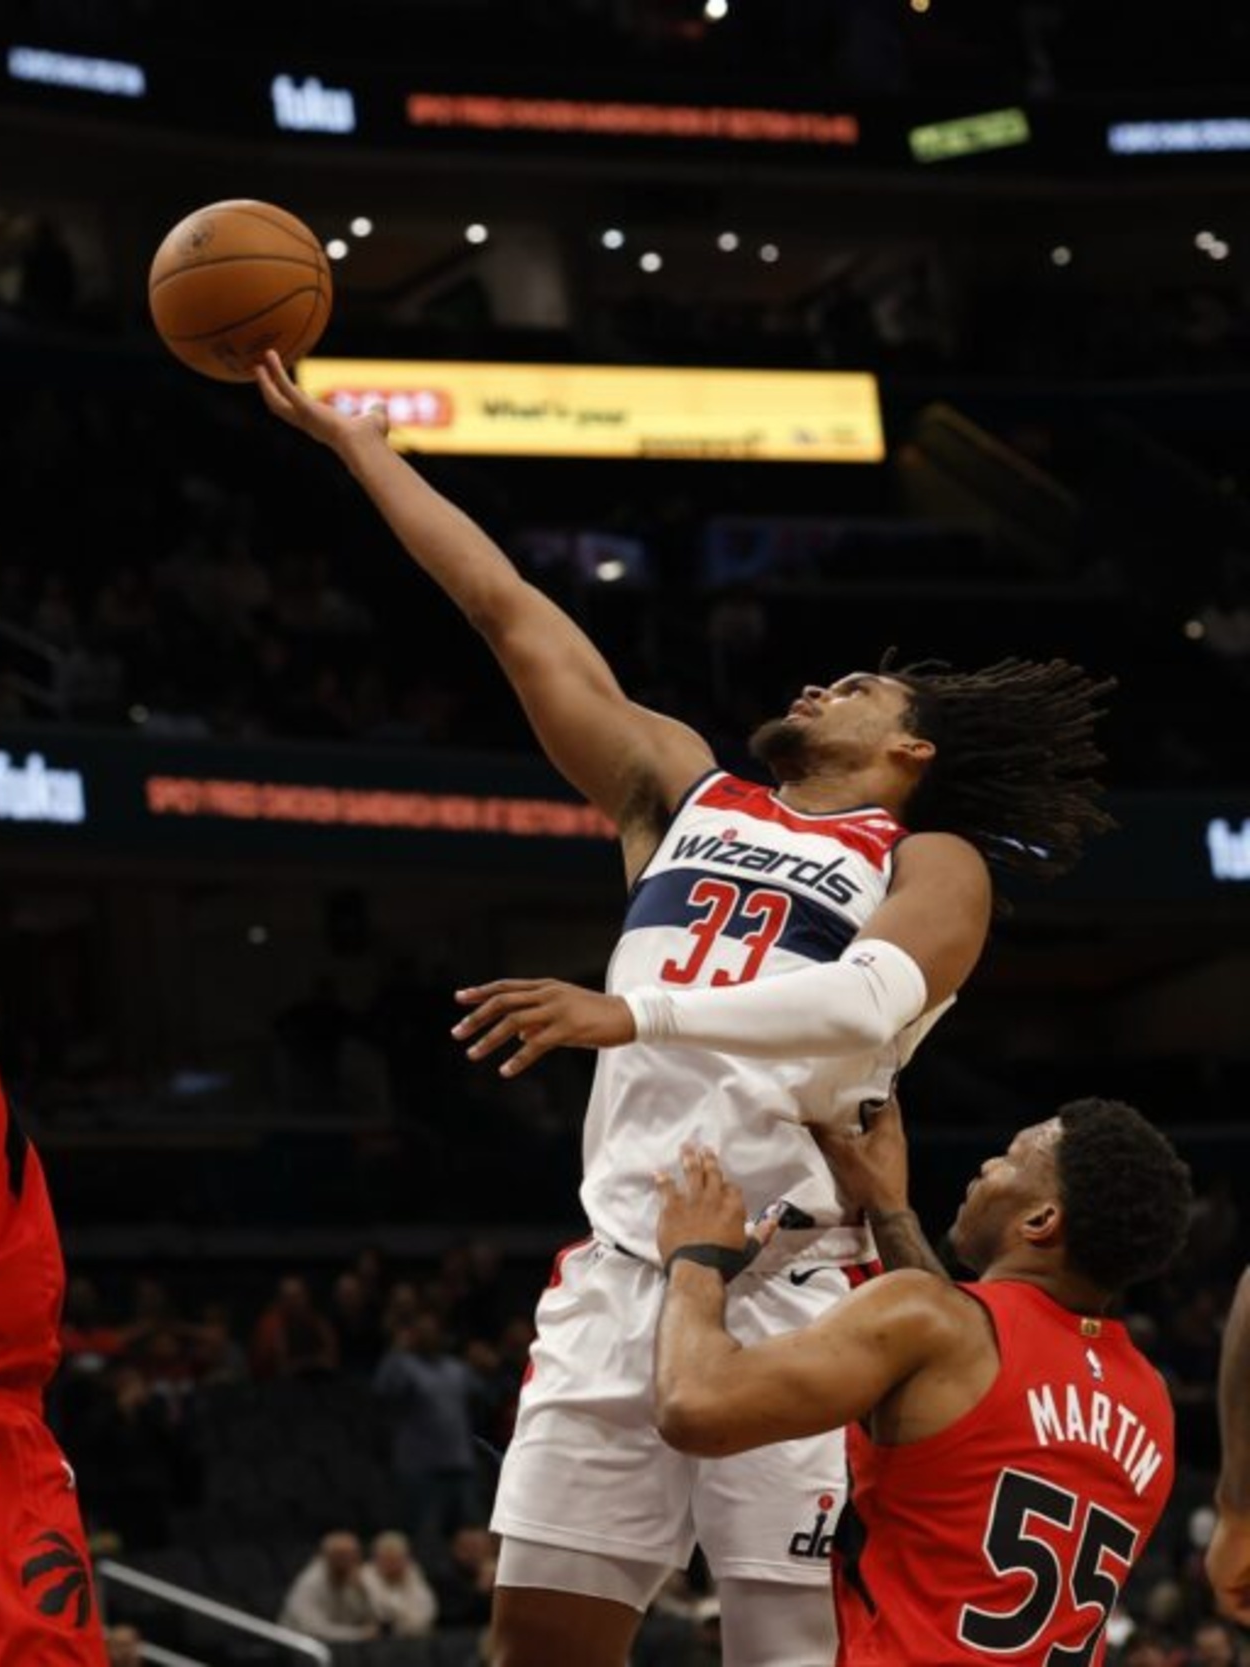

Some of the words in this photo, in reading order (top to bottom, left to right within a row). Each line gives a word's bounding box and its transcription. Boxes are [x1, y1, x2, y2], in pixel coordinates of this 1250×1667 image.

[670, 828, 862, 906] wizards
[661, 877, 792, 988] 33
[1027, 1383, 1163, 1497] MARTIN
[956, 1466, 1140, 1667] 55
